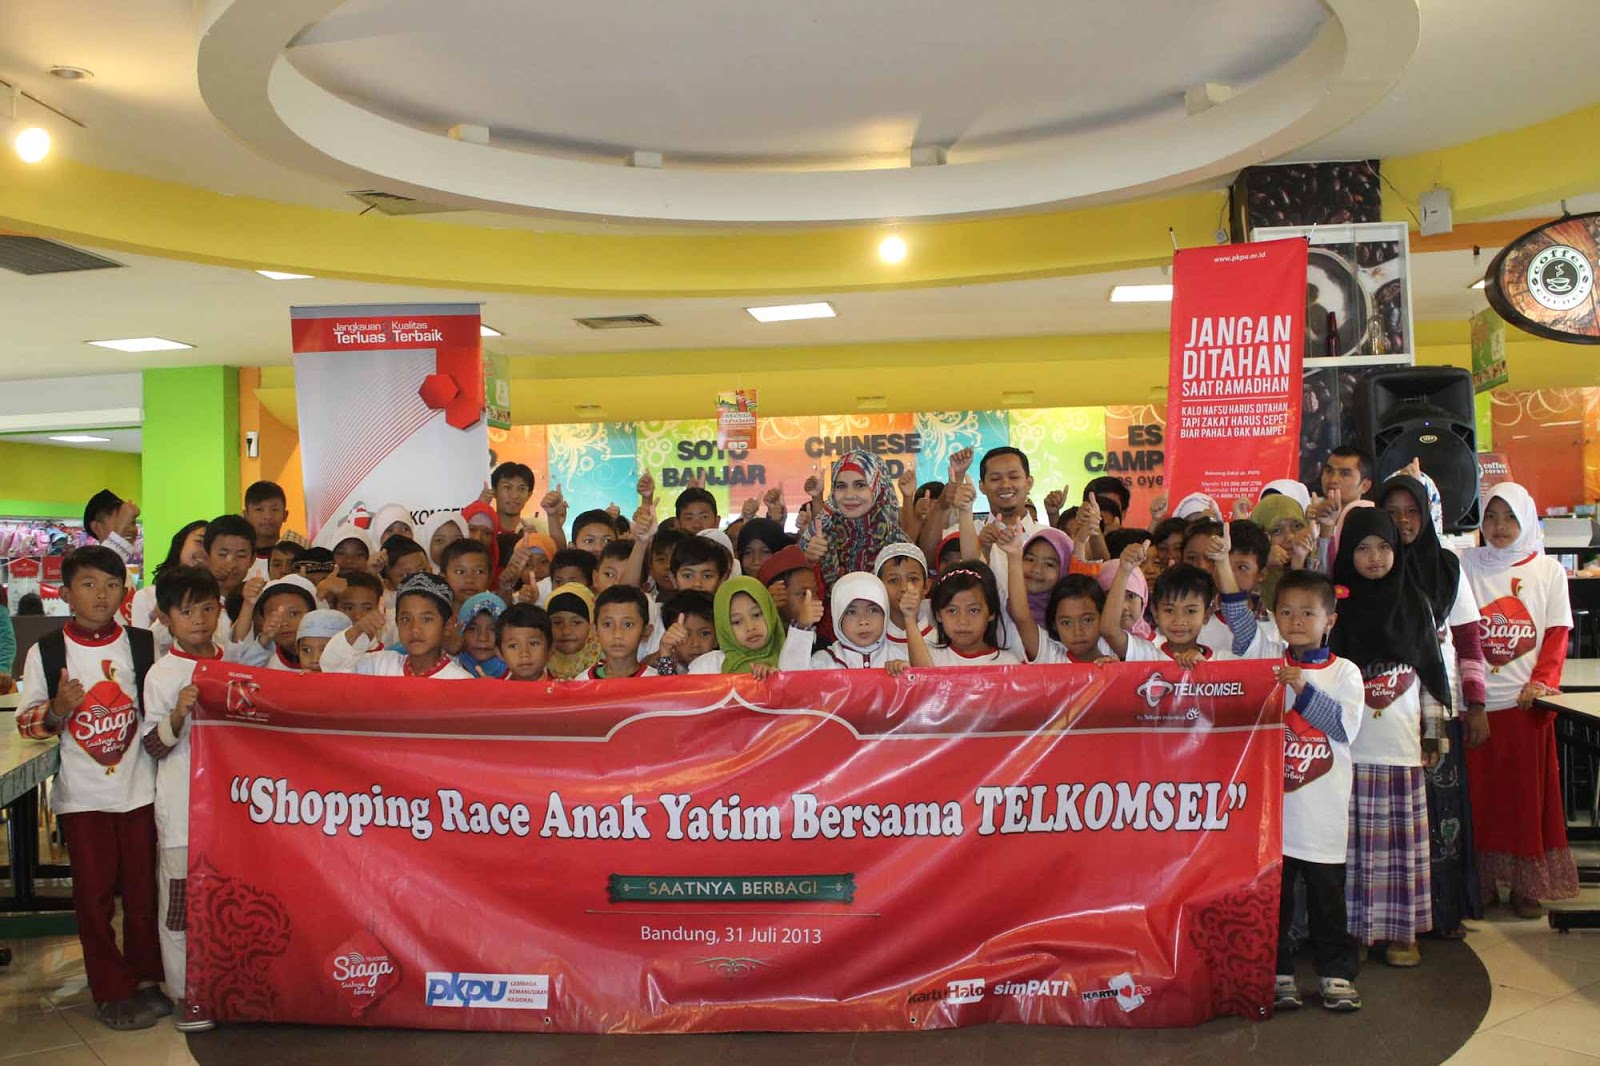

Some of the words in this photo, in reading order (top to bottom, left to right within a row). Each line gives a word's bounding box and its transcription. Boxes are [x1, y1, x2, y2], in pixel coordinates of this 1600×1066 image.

[333, 322, 382, 333] Jangkauan
[391, 320, 428, 330] Kualitas
[334, 331, 387, 344] Terluas
[392, 329, 443, 343] Terbaik
[1185, 315, 1291, 347] JANGAN
[1183, 345, 1291, 379] DITAHAN
[1182, 380, 1214, 397] SAAT
[1215, 376, 1289, 396] RAMADHAN
[1181, 406, 1202, 417] KALO
[1202, 405, 1228, 416] NAFSU
[1228, 404, 1255, 414] HARUS
[1255, 402, 1288, 413] DITAHAN
[1181, 417, 1201, 428] TAPI
[1201, 416, 1229, 427] ZAKAT
[1231, 415, 1261, 426] HARUS
[1263, 413, 1289, 426] CEPET
[1128, 424, 1163, 447] ES
[1180, 429, 1200, 439] BIAR
[1201, 427, 1232, 438] PAHALA
[1233, 427, 1250, 437] GAK
[1252, 426, 1287, 437] MAMPET
[804, 433, 921, 459] CHINESE
[1084, 450, 1165, 473] CAMP
[662, 464, 767, 487] BANJAR
[1478, 615, 1536, 649] Siaga
[1172, 682, 1245, 697] TELKOMSEL
[75, 709, 136, 741] Siaga
[437, 788, 531, 836] Race
[539, 791, 651, 839] Anak
[658, 793, 782, 841] Yatim
[790, 793, 964, 839] Bersama
[648, 881, 736, 896] SAATNYA
[742, 881, 818, 896] BERBAGI
[640, 925, 720, 945] Bandung,
[724, 927, 743, 943] 31
[748, 928, 777, 944] Juli
[781, 928, 822, 944] 2013
[333, 956, 394, 987] Siaga
[427, 972, 507, 1007] pkpu
[993, 979, 1071, 997] simPATI
[1083, 988, 1118, 1000] KARTU
